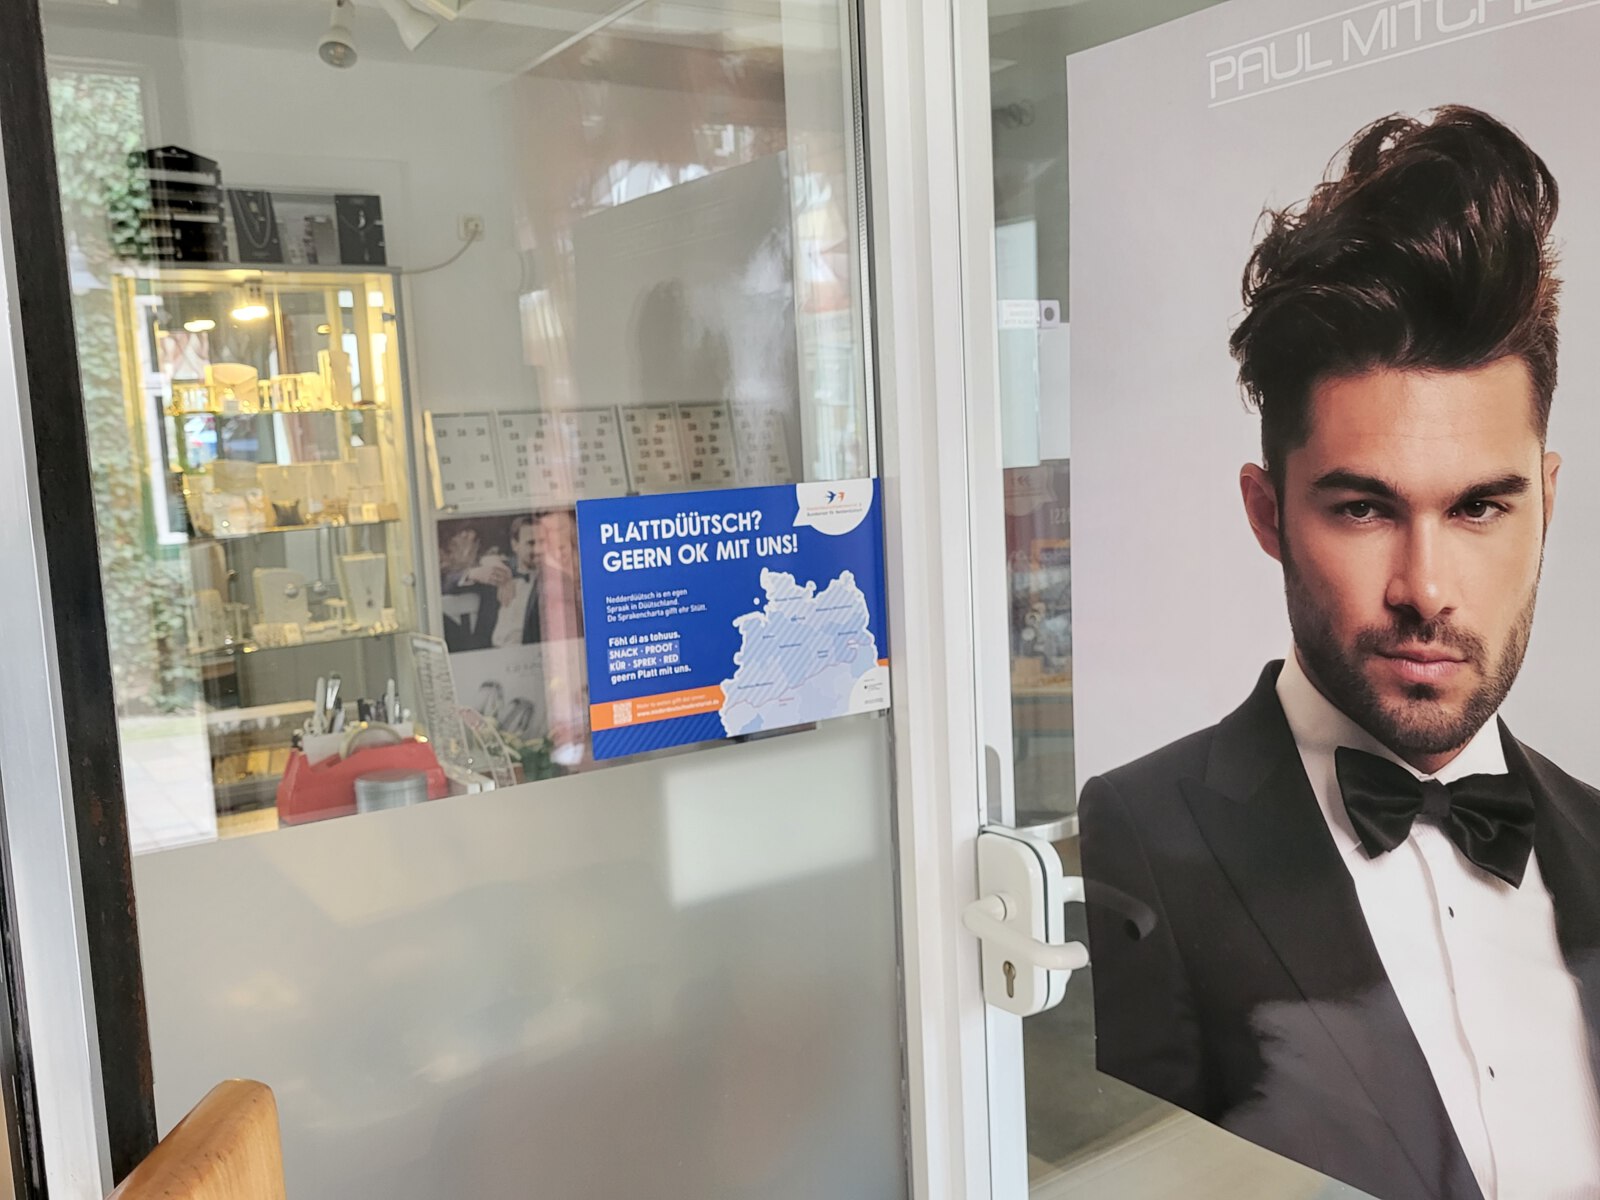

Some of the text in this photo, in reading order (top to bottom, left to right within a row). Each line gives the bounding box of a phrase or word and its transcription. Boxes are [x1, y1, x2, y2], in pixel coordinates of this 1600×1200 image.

[1209, 31, 1333, 99] PAUL
[600, 510, 762, 544] PLATTDÜÜTSCH?
[603, 533, 798, 572] GEERN OK MIT UNS!
[607, 614, 617, 622] De
[609, 631, 681, 647] Föhl di as tohuus.
[609, 642, 673, 659] SNACK PROOT
[633, 656, 657, 668] SPREK
[663, 653, 679, 664] RED
[611, 664, 691, 685] geern Platt mit uns.
